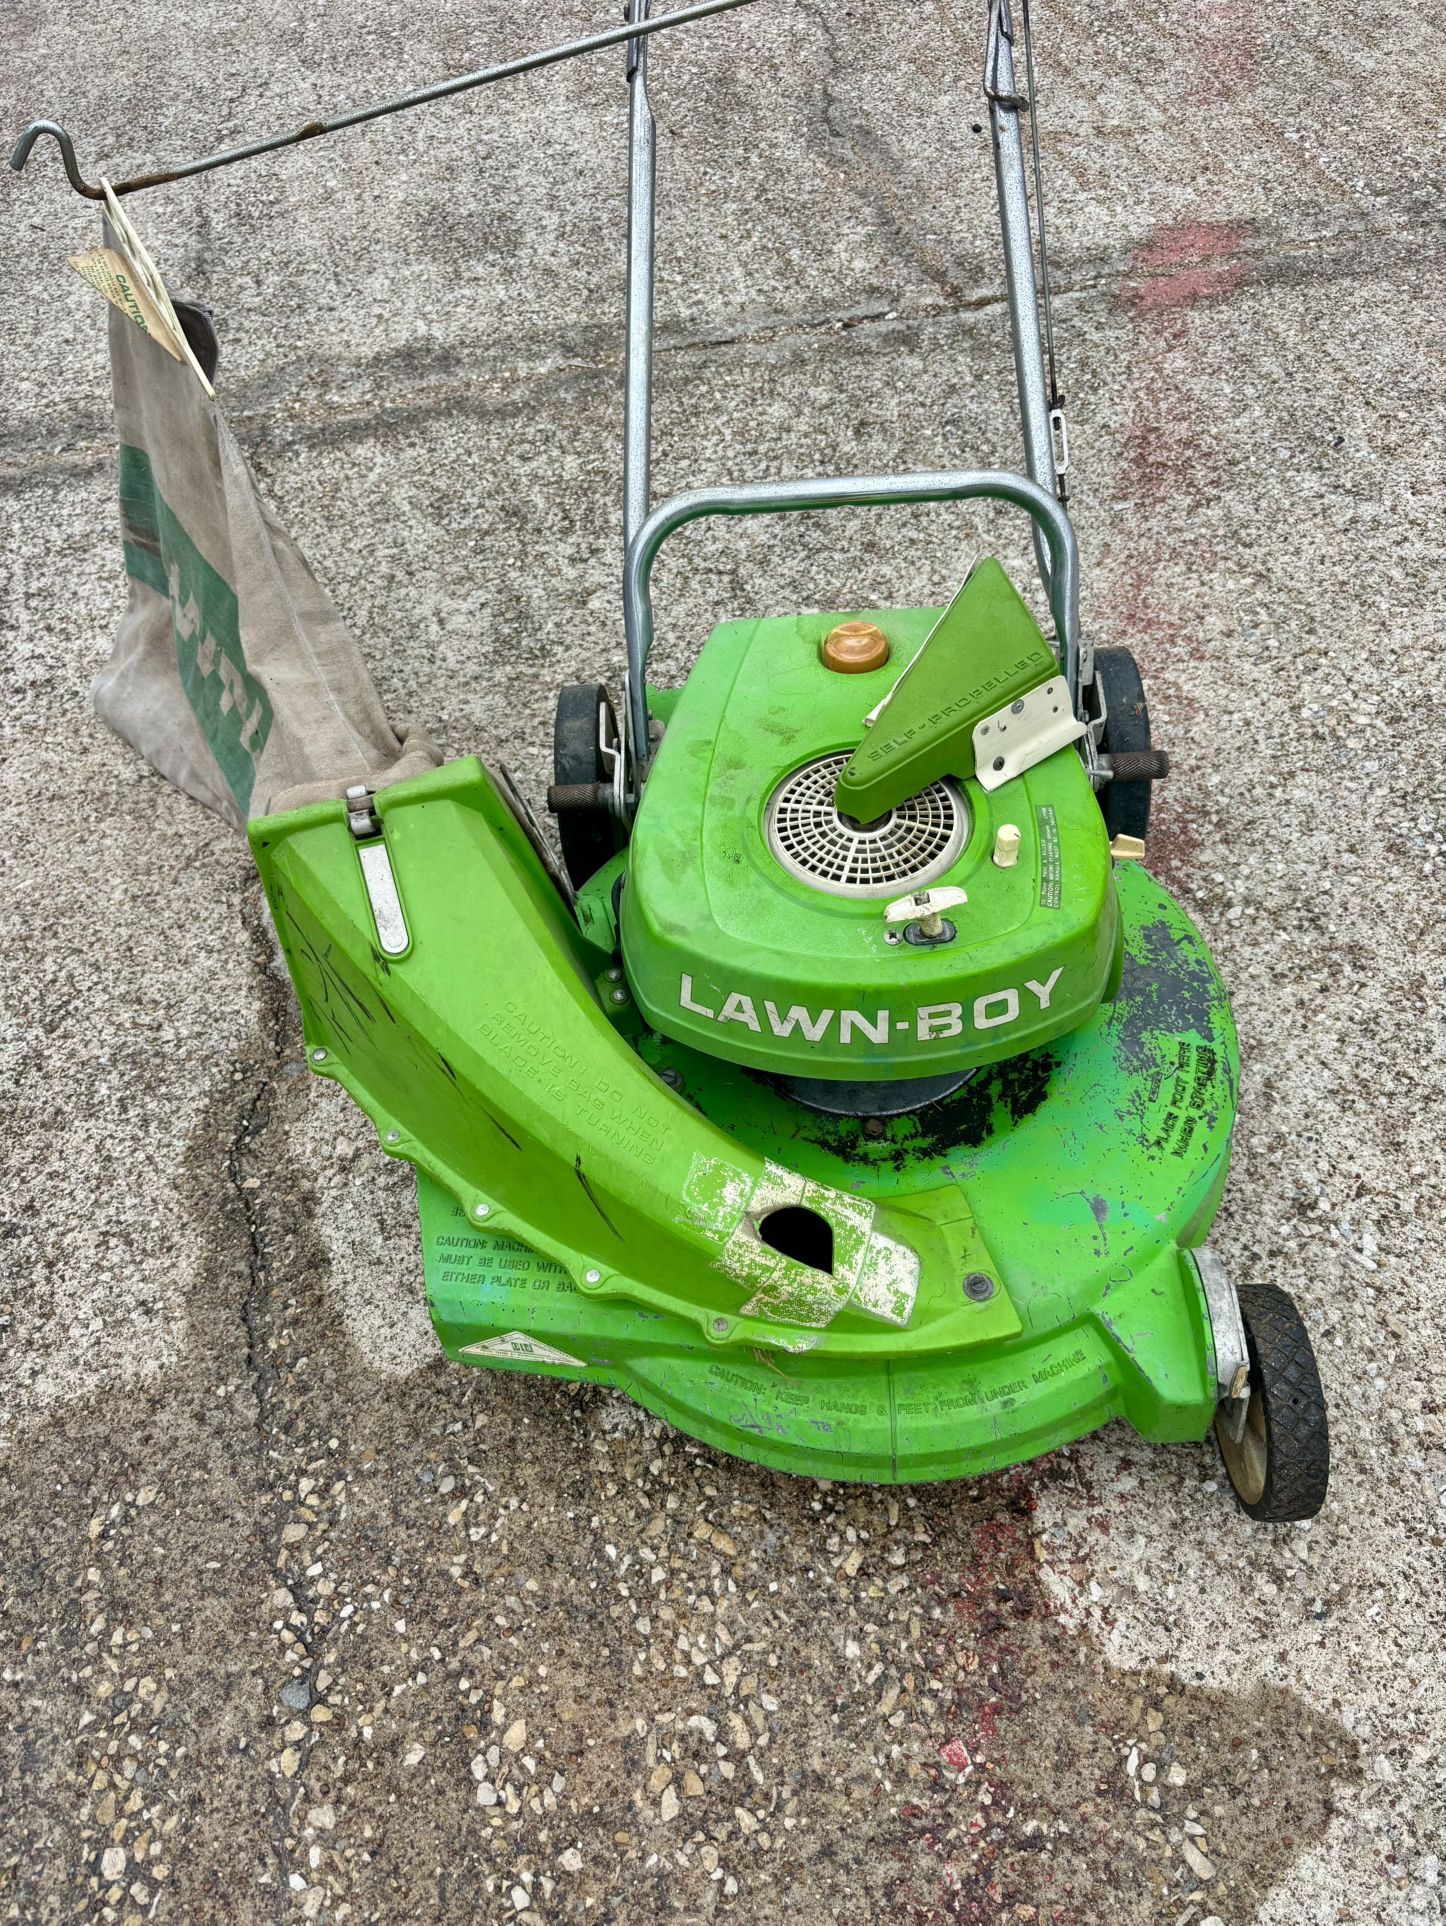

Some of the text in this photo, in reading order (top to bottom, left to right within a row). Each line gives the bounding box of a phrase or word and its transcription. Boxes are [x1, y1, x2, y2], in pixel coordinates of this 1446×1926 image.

[866, 651, 1044, 762] SELF-PROPELLED
[679, 966, 1065, 1045] LAWN-BOY
[491, 1012, 665, 1150] REMOVE BAG WHEN
[595, 1079, 623, 1103] DO
[632, 1105, 671, 1135] NOT
[1170, 1075, 1189, 1110] FOOT
[1170, 1045, 1210, 1159] WHEN STARTING
[546, 1083, 567, 1102] IS
[575, 1105, 656, 1165] TURNING
[436, 1235, 488, 1250] CAUTION:
[438, 1252, 473, 1266] MUST
[478, 1256, 494, 1268] BE
[498, 1257, 530, 1272] USED
[441, 1270, 576, 1294] EITHER PLATE OR BA
[708, 1350, 1087, 1417] CAUTION: KEEP HANDS & FEET FROM UNDER MACHINE
